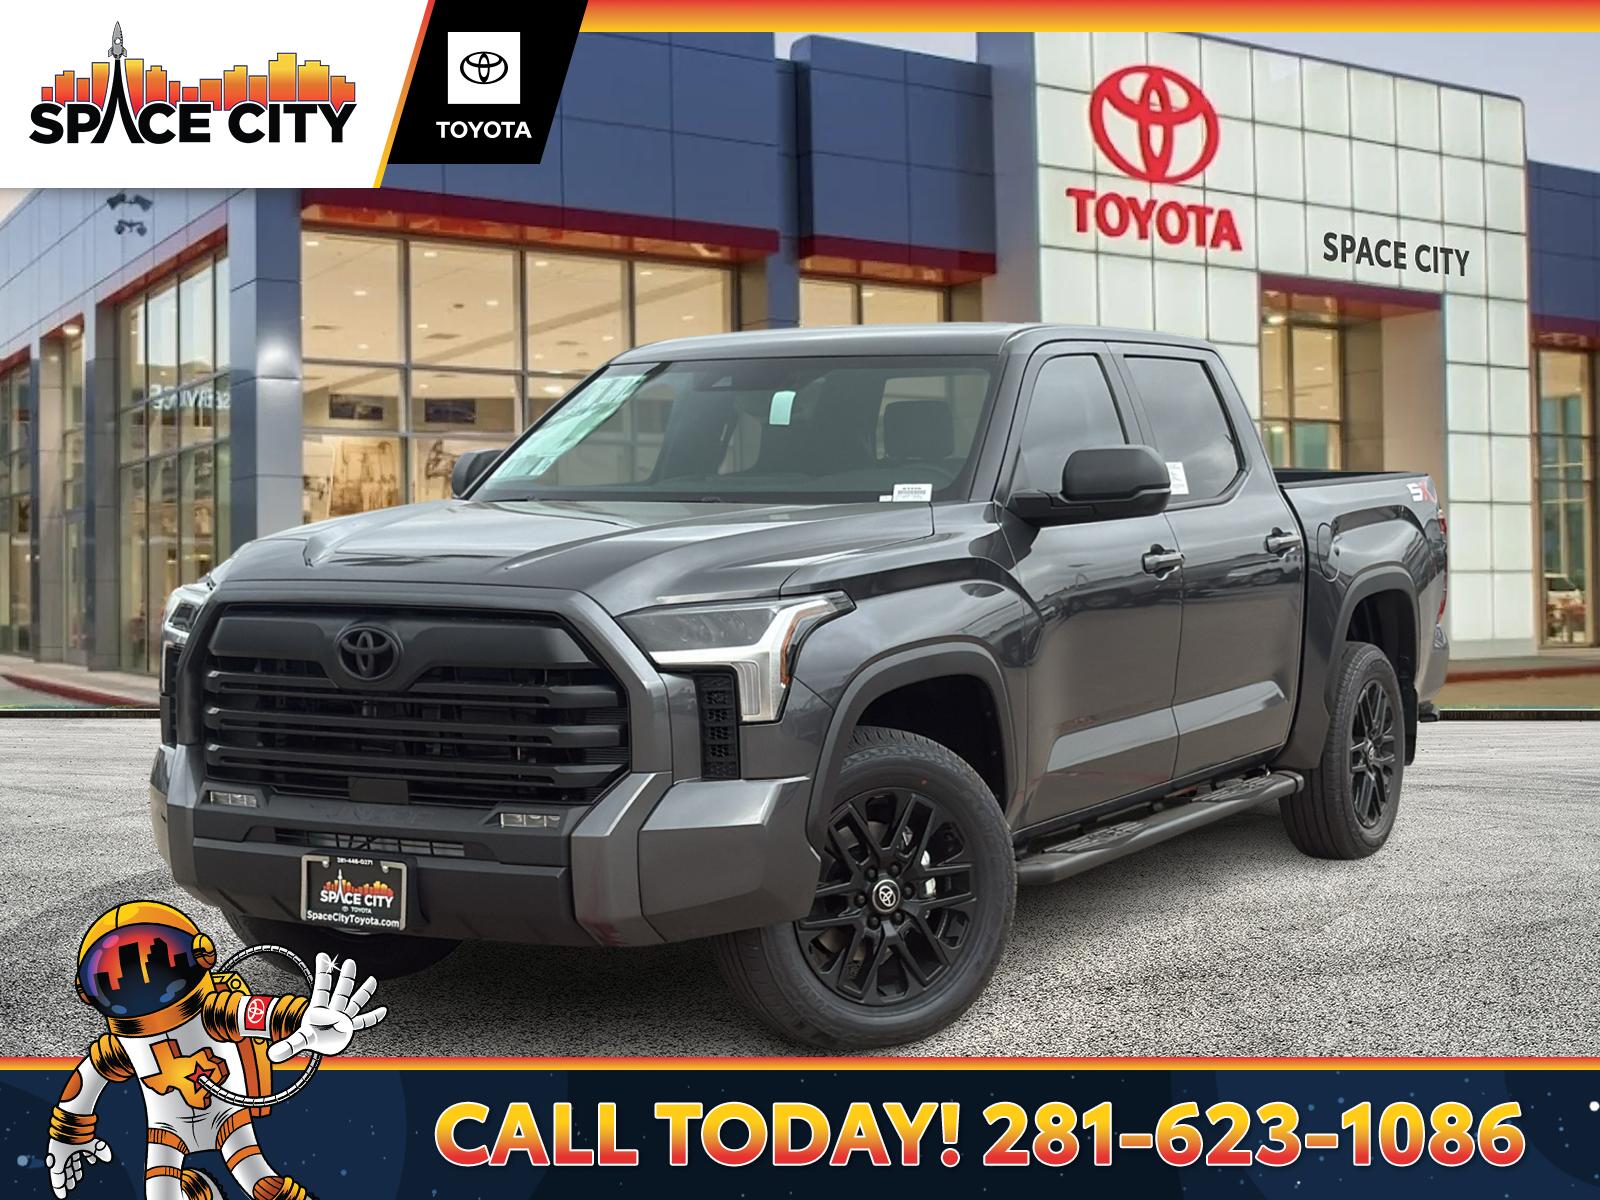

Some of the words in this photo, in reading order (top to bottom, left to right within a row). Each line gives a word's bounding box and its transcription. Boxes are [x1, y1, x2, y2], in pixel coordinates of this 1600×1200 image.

[1066, 187, 1242, 251] TOYOTA
[1323, 231, 1407, 270] SPACE
[1414, 243, 1470, 277] CITY
[320, 889, 361, 905] SPACE
[364, 894, 394, 909] CITY
[306, 909, 400, 928] SpaceCityToyota.com
[351, 906, 372, 914] TOYOTA
